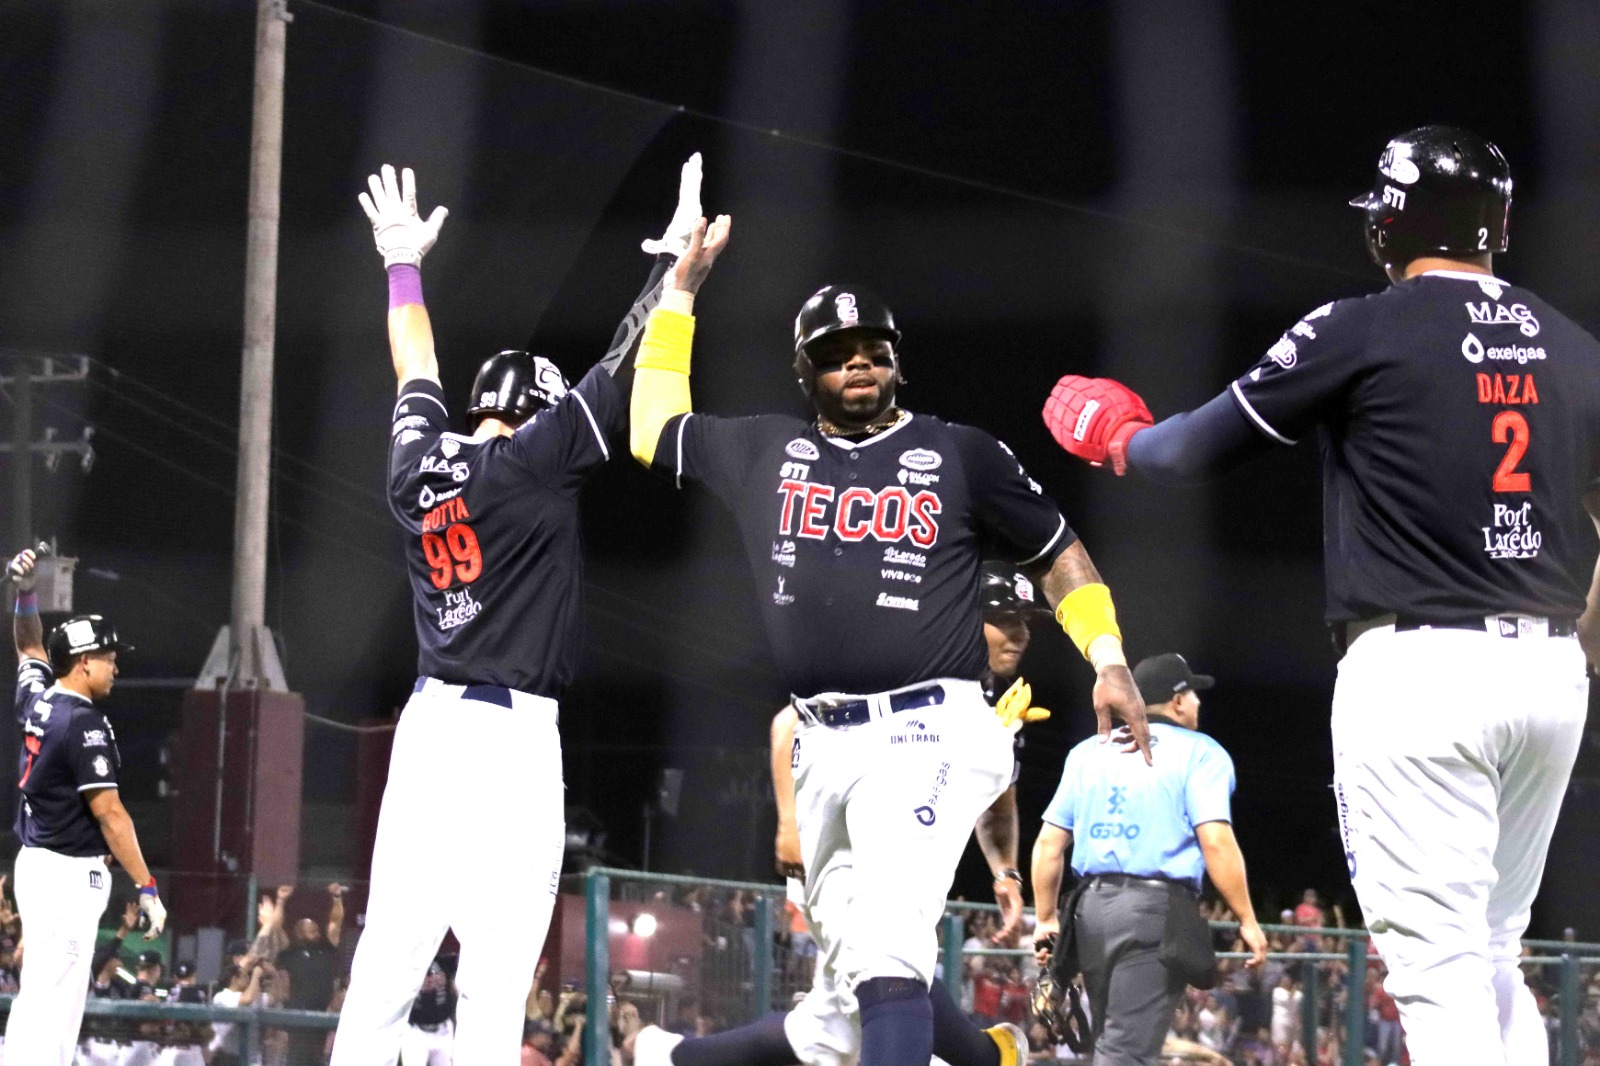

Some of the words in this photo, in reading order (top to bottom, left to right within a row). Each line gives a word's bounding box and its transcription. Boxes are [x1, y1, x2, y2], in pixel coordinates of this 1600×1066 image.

[1382, 184, 1406, 211] STI
[1477, 227, 1488, 250] 2
[1464, 301, 1540, 337] MAG
[1486, 344, 1547, 364] exelgas
[480, 391, 498, 408] 99
[1476, 373, 1540, 405] DAZA
[1491, 410, 1532, 493] 2
[779, 461, 810, 481] STI
[777, 478, 943, 550] TECOS
[1493, 501, 1532, 527] Port
[1481, 525, 1542, 552] Laredo
[421, 522, 483, 591] 99
